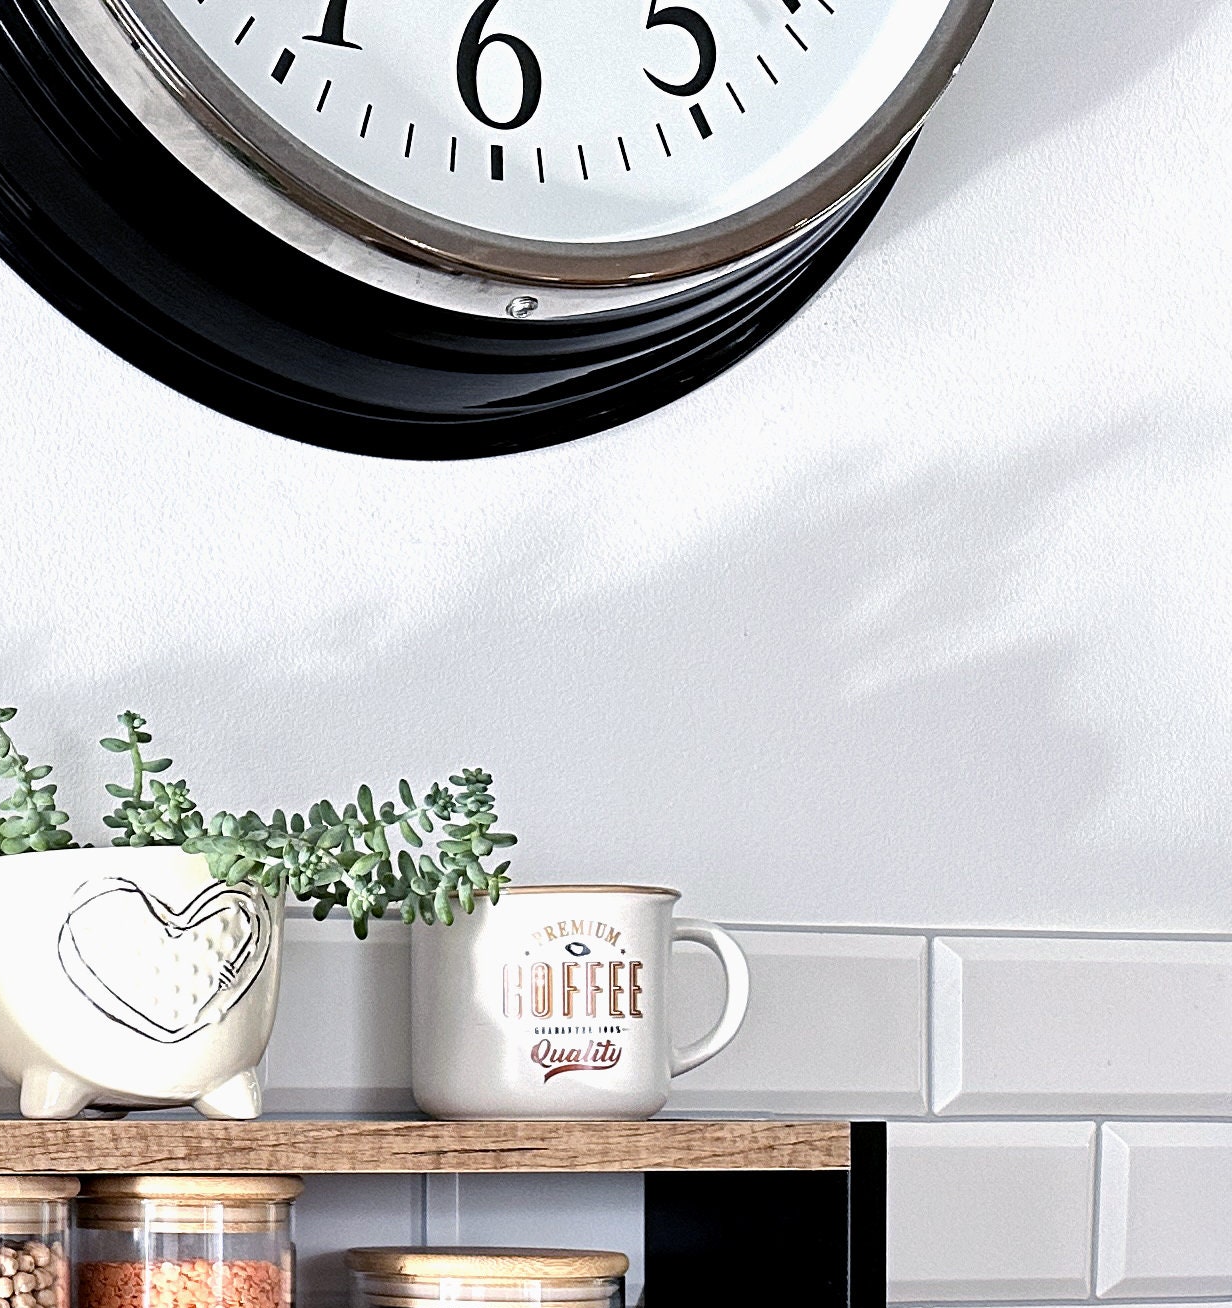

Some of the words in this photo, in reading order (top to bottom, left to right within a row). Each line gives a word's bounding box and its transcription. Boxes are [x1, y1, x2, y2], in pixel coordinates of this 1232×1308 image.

[456, 0, 542, 130] 6
[642, 0, 717, 97] 5
[532, 919, 622, 947] PREMIUM
[502, 961, 644, 1019] COFFEE
[530, 1038, 623, 1084] Quality
